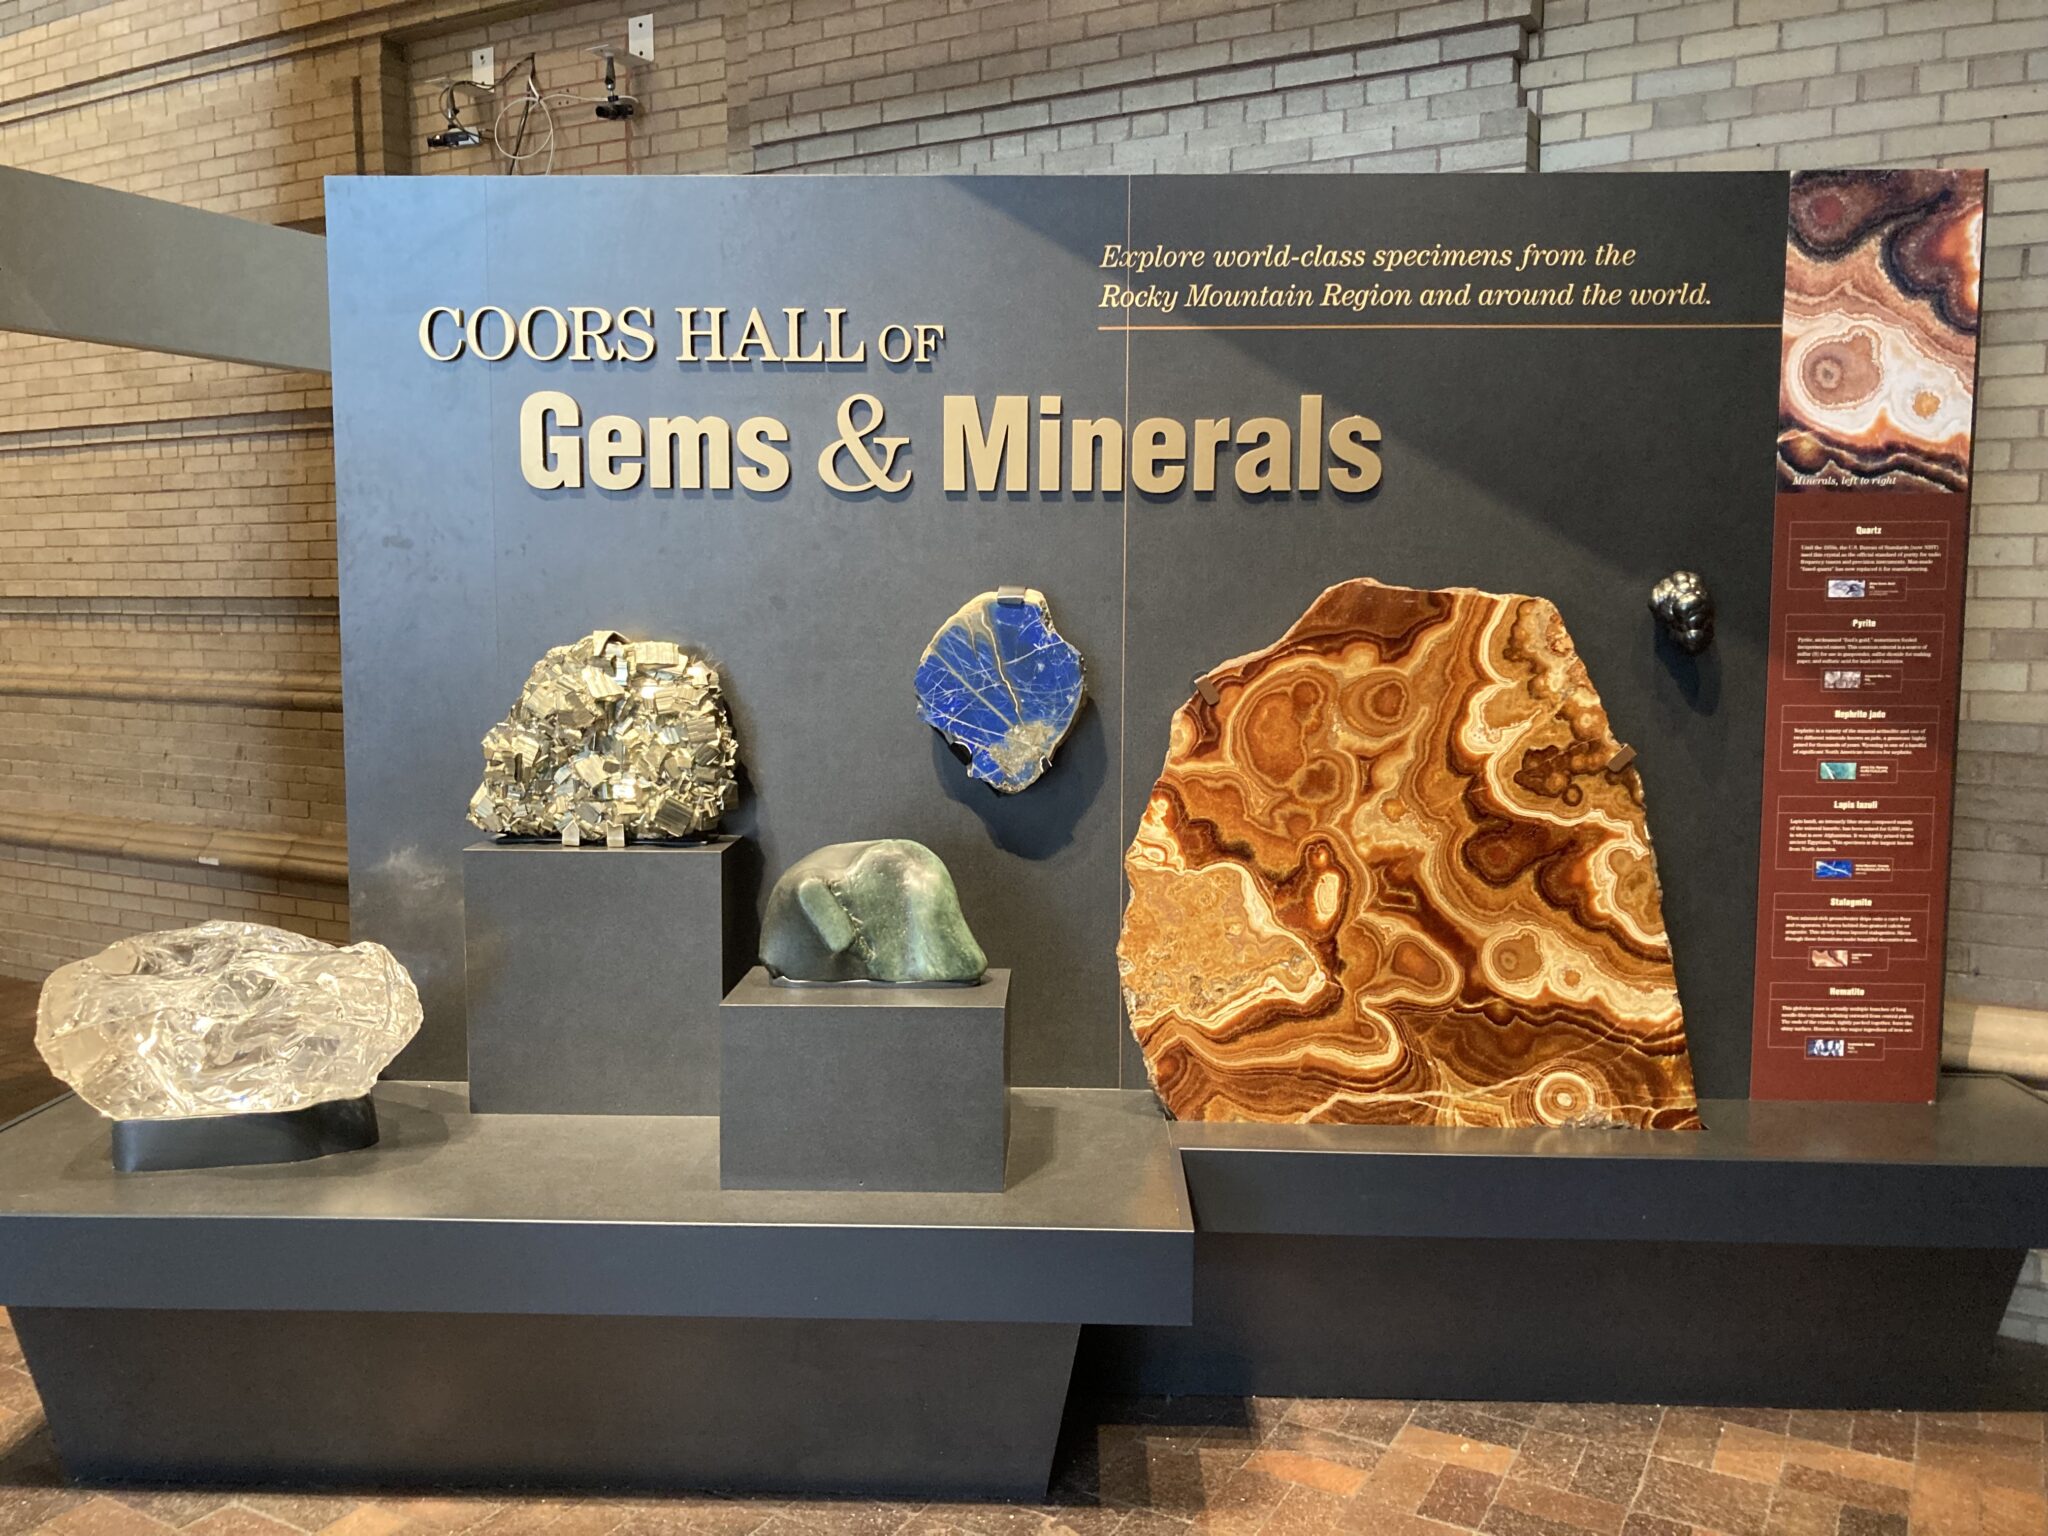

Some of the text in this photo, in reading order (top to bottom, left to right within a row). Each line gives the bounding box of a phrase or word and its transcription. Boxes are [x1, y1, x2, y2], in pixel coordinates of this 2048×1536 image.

[1100, 243, 1637, 271] Explore world-class specimens from the
[1100, 283, 1712, 312] Rocky Mountain Region and around the world.
[418, 306, 945, 363] COORS HALL OF
[519, 391, 1383, 494] Gems & Minerals
[1792, 476, 1896, 487] Minerals, left to right
[1856, 526, 1882, 535] Quartz
[1852, 619, 1877, 629] Pyrite
[1834, 709, 1886, 720] Nephrite jade
[1833, 801, 1878, 811] Lapis lazuli
[1830, 897, 1872, 907] Stalagmite
[1829, 987, 1865, 996] Hematite
